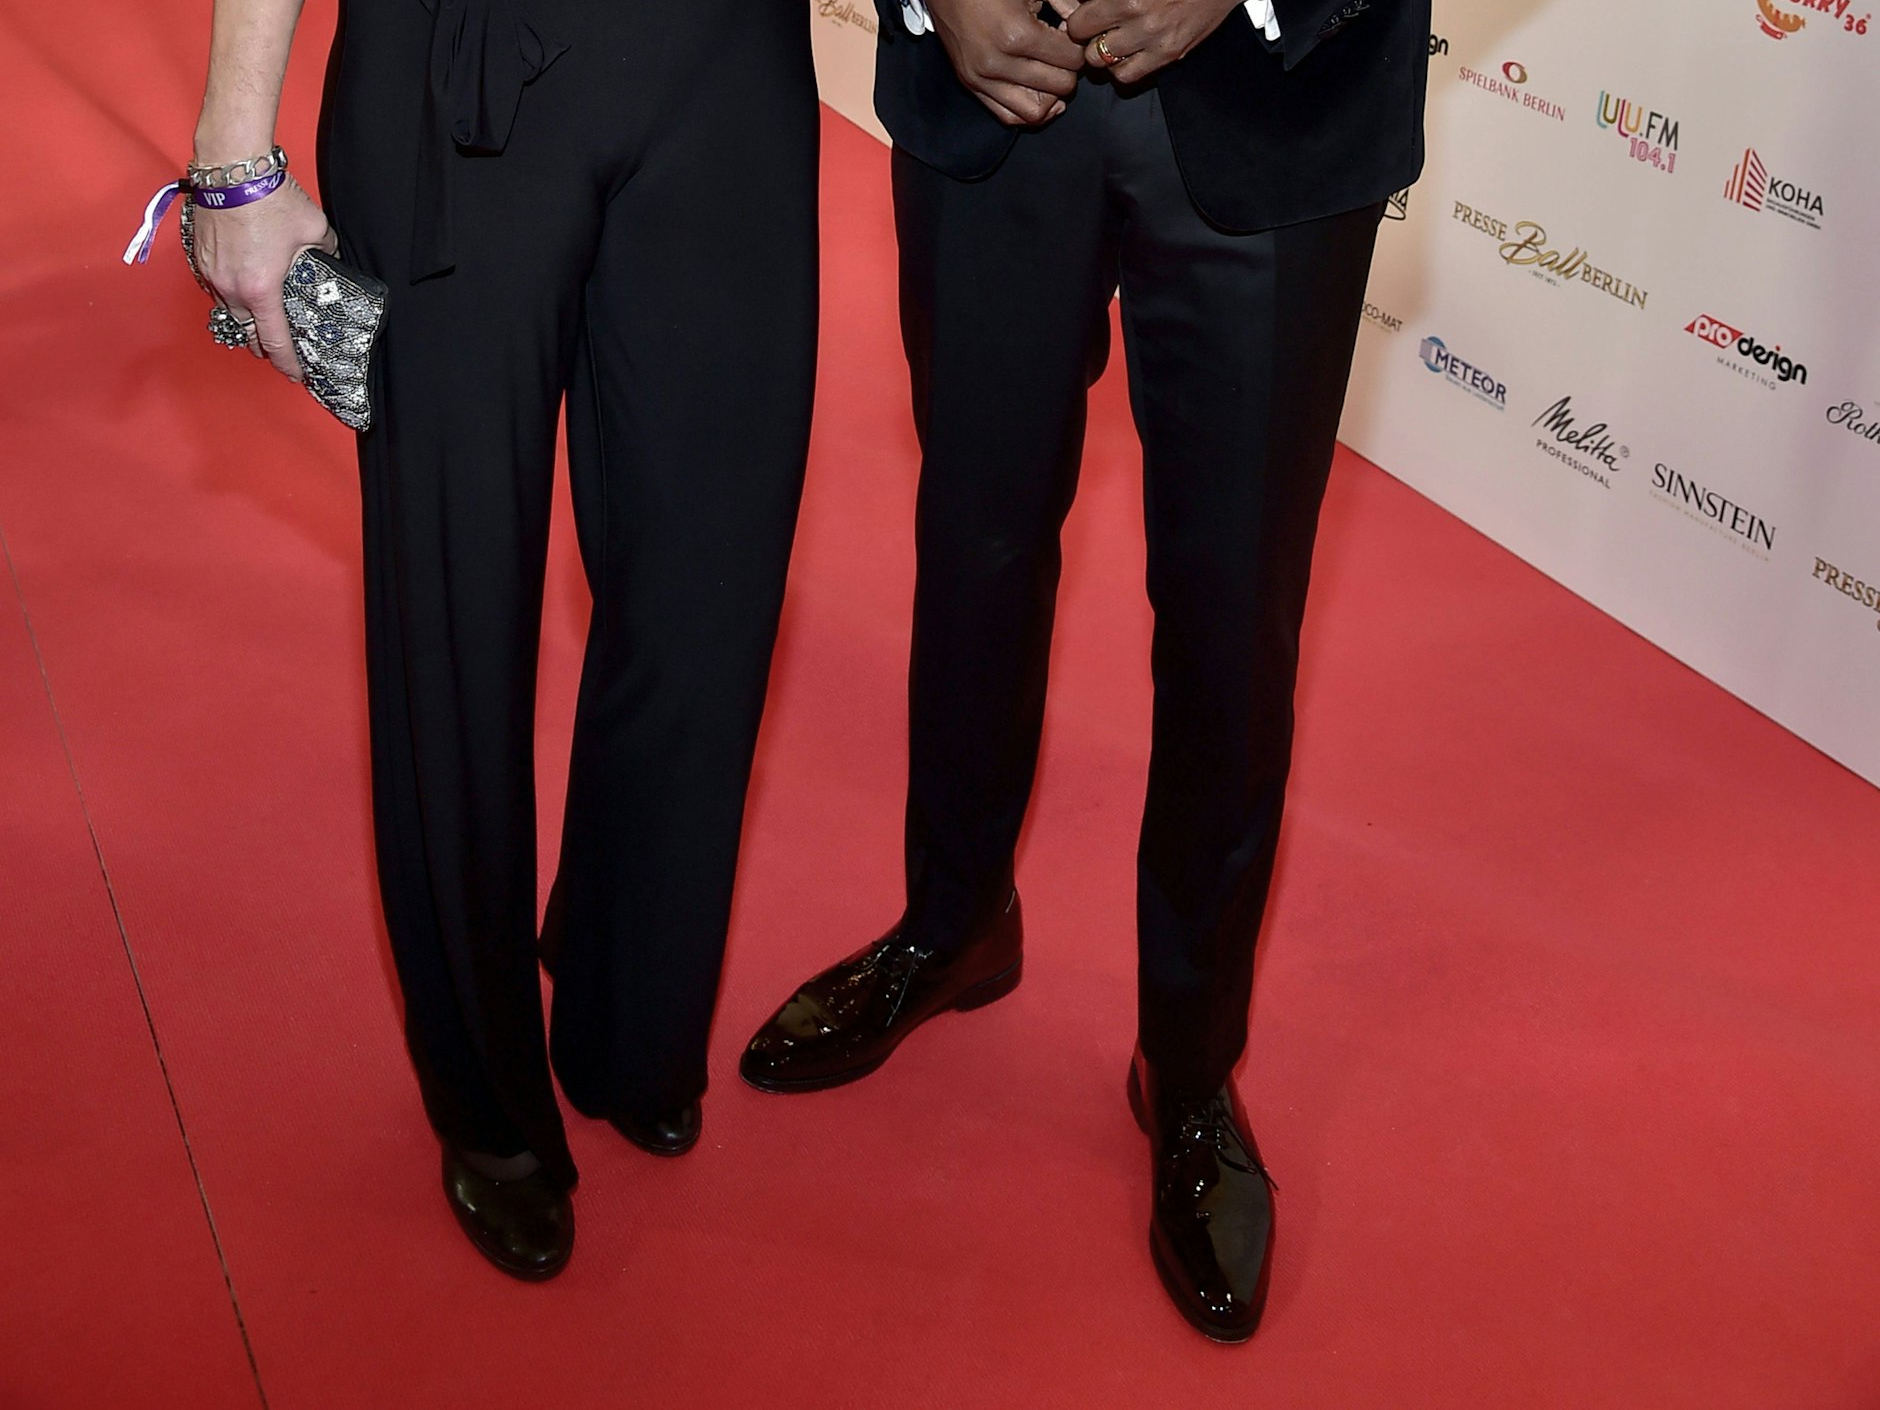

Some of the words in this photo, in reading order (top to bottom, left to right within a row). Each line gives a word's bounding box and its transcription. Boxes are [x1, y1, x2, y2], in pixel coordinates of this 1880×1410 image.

[1843, 14, 1867, 36] 36
[1458, 66, 1520, 103] SPIELBANK
[1523, 92, 1566, 122] BERLIN
[1628, 137, 1677, 174] 104.1
[203, 192, 226, 206] VIP
[1768, 176, 1825, 216] KOHA
[1452, 200, 1508, 242] PRESSE
[1499, 220, 1588, 280] Ball
[1580, 262, 1648, 310] BERLIN
[1435, 346, 1507, 405] METEOR
[1716, 355, 1777, 391] MARKETING
[1531, 396, 1621, 472] Melitta
[1536, 439, 1611, 490] PROFESSIONAL
[1651, 462, 1776, 551] SINNSTEIN
